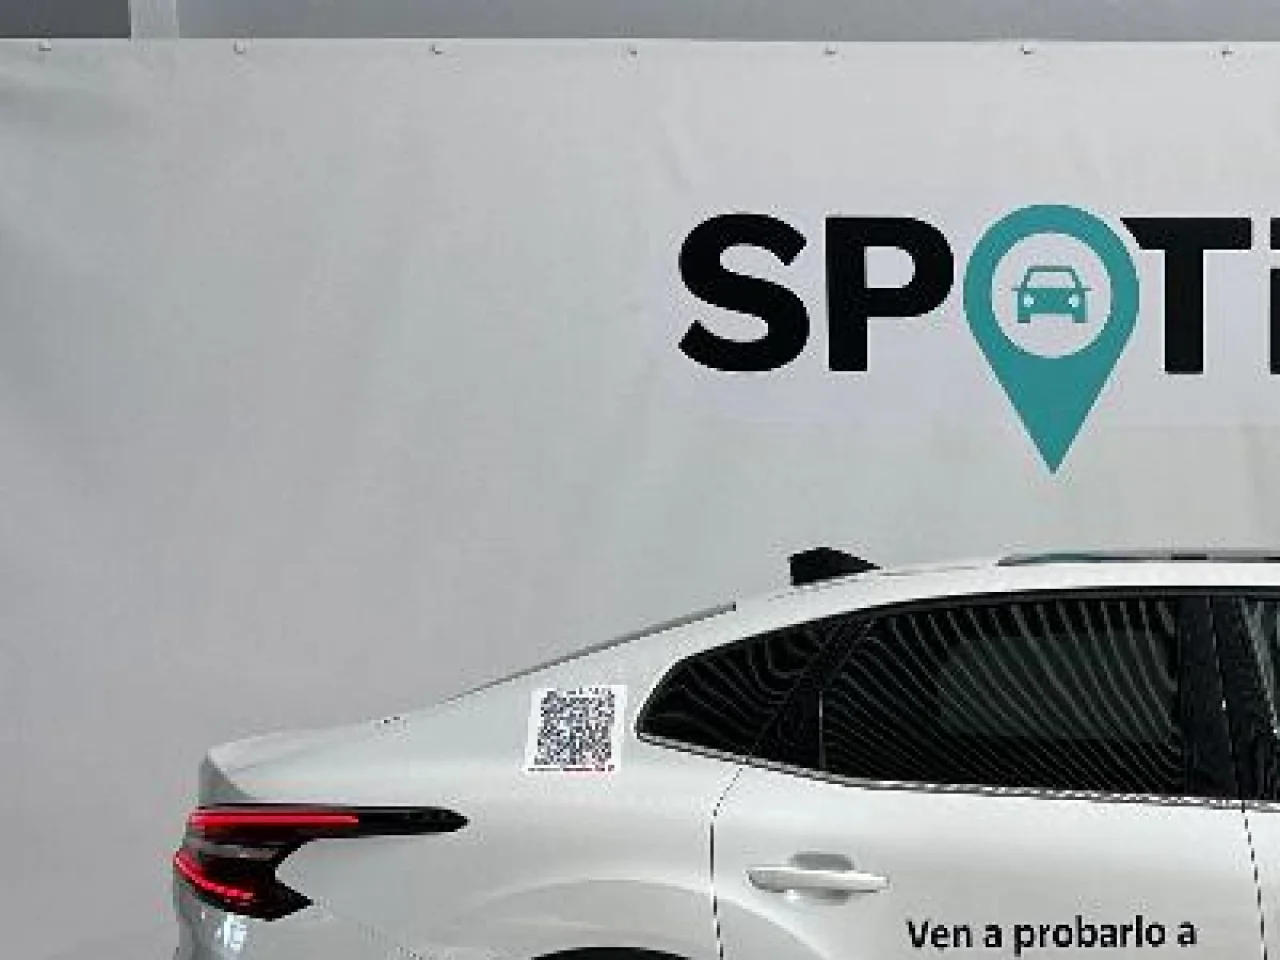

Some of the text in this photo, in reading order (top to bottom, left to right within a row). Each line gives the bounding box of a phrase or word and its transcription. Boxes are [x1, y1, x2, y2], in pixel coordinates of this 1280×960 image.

[907, 914, 1198, 957] Ven a probarlo a
